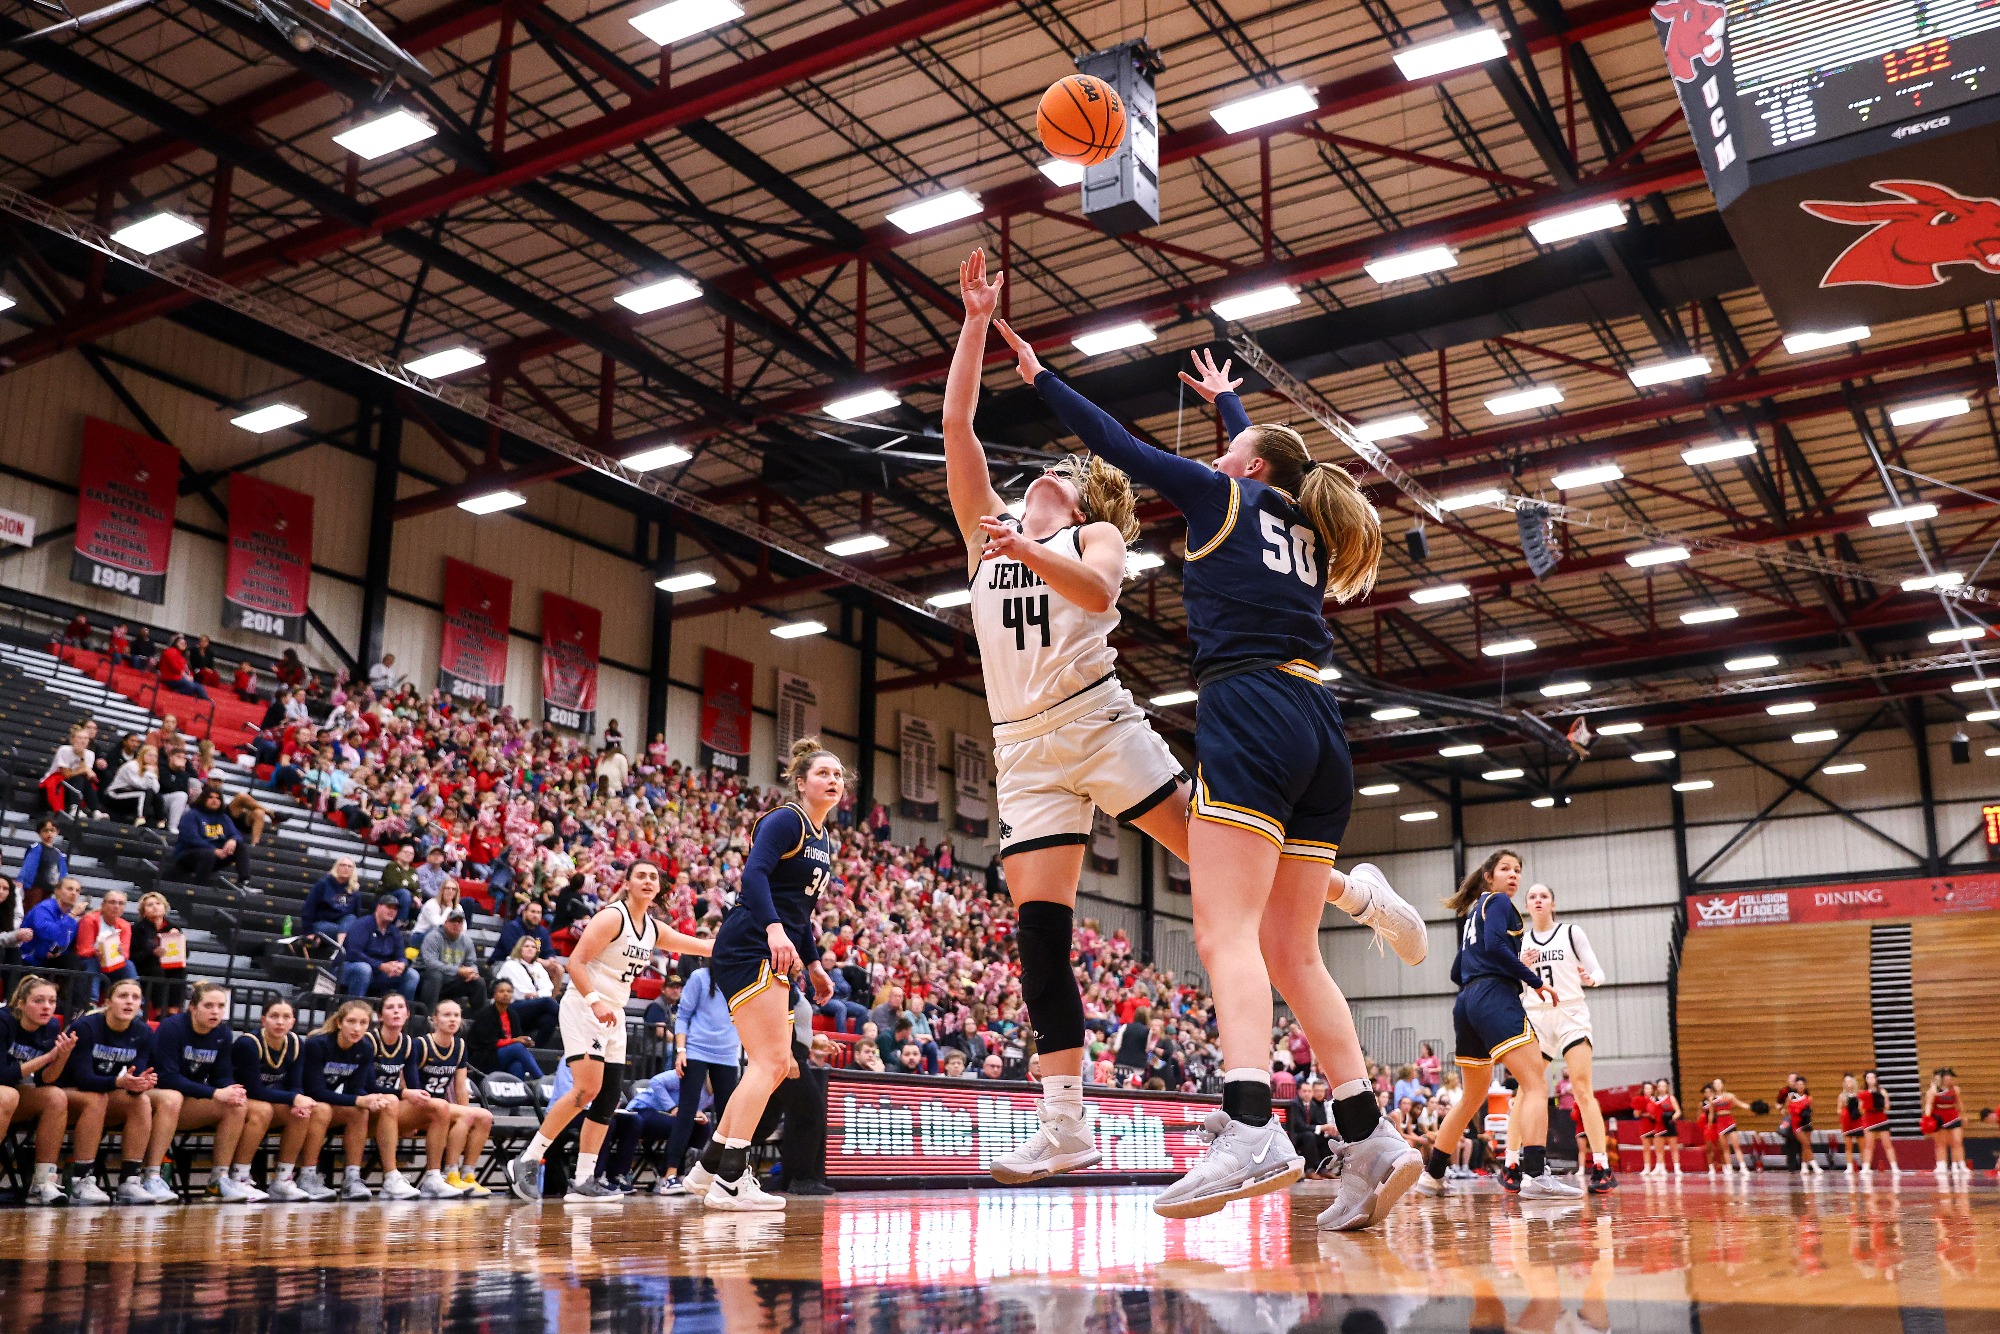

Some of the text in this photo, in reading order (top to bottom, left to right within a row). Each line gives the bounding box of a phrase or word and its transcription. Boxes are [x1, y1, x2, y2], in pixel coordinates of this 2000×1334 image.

[1702, 74, 1737, 172] UCM
[86, 486, 164, 520] BASKETBALL
[93, 530, 148, 554] NATIONAL
[1259, 509, 1318, 588] 50
[87, 543, 153, 570] CHAMPIONS
[92, 564, 141, 595] 1984
[241, 610, 285, 636] 2014
[1003, 594, 1051, 650] 44
[550, 707, 580, 728] 2015
[805, 867, 830, 899] 34
[1739, 893, 1788, 905] COLLISION
[1740, 903, 1789, 917] LEADERS
[1815, 889, 1883, 906] DINING
[425, 1077, 449, 1093] 22
[488, 1081, 527, 1098] UCM
